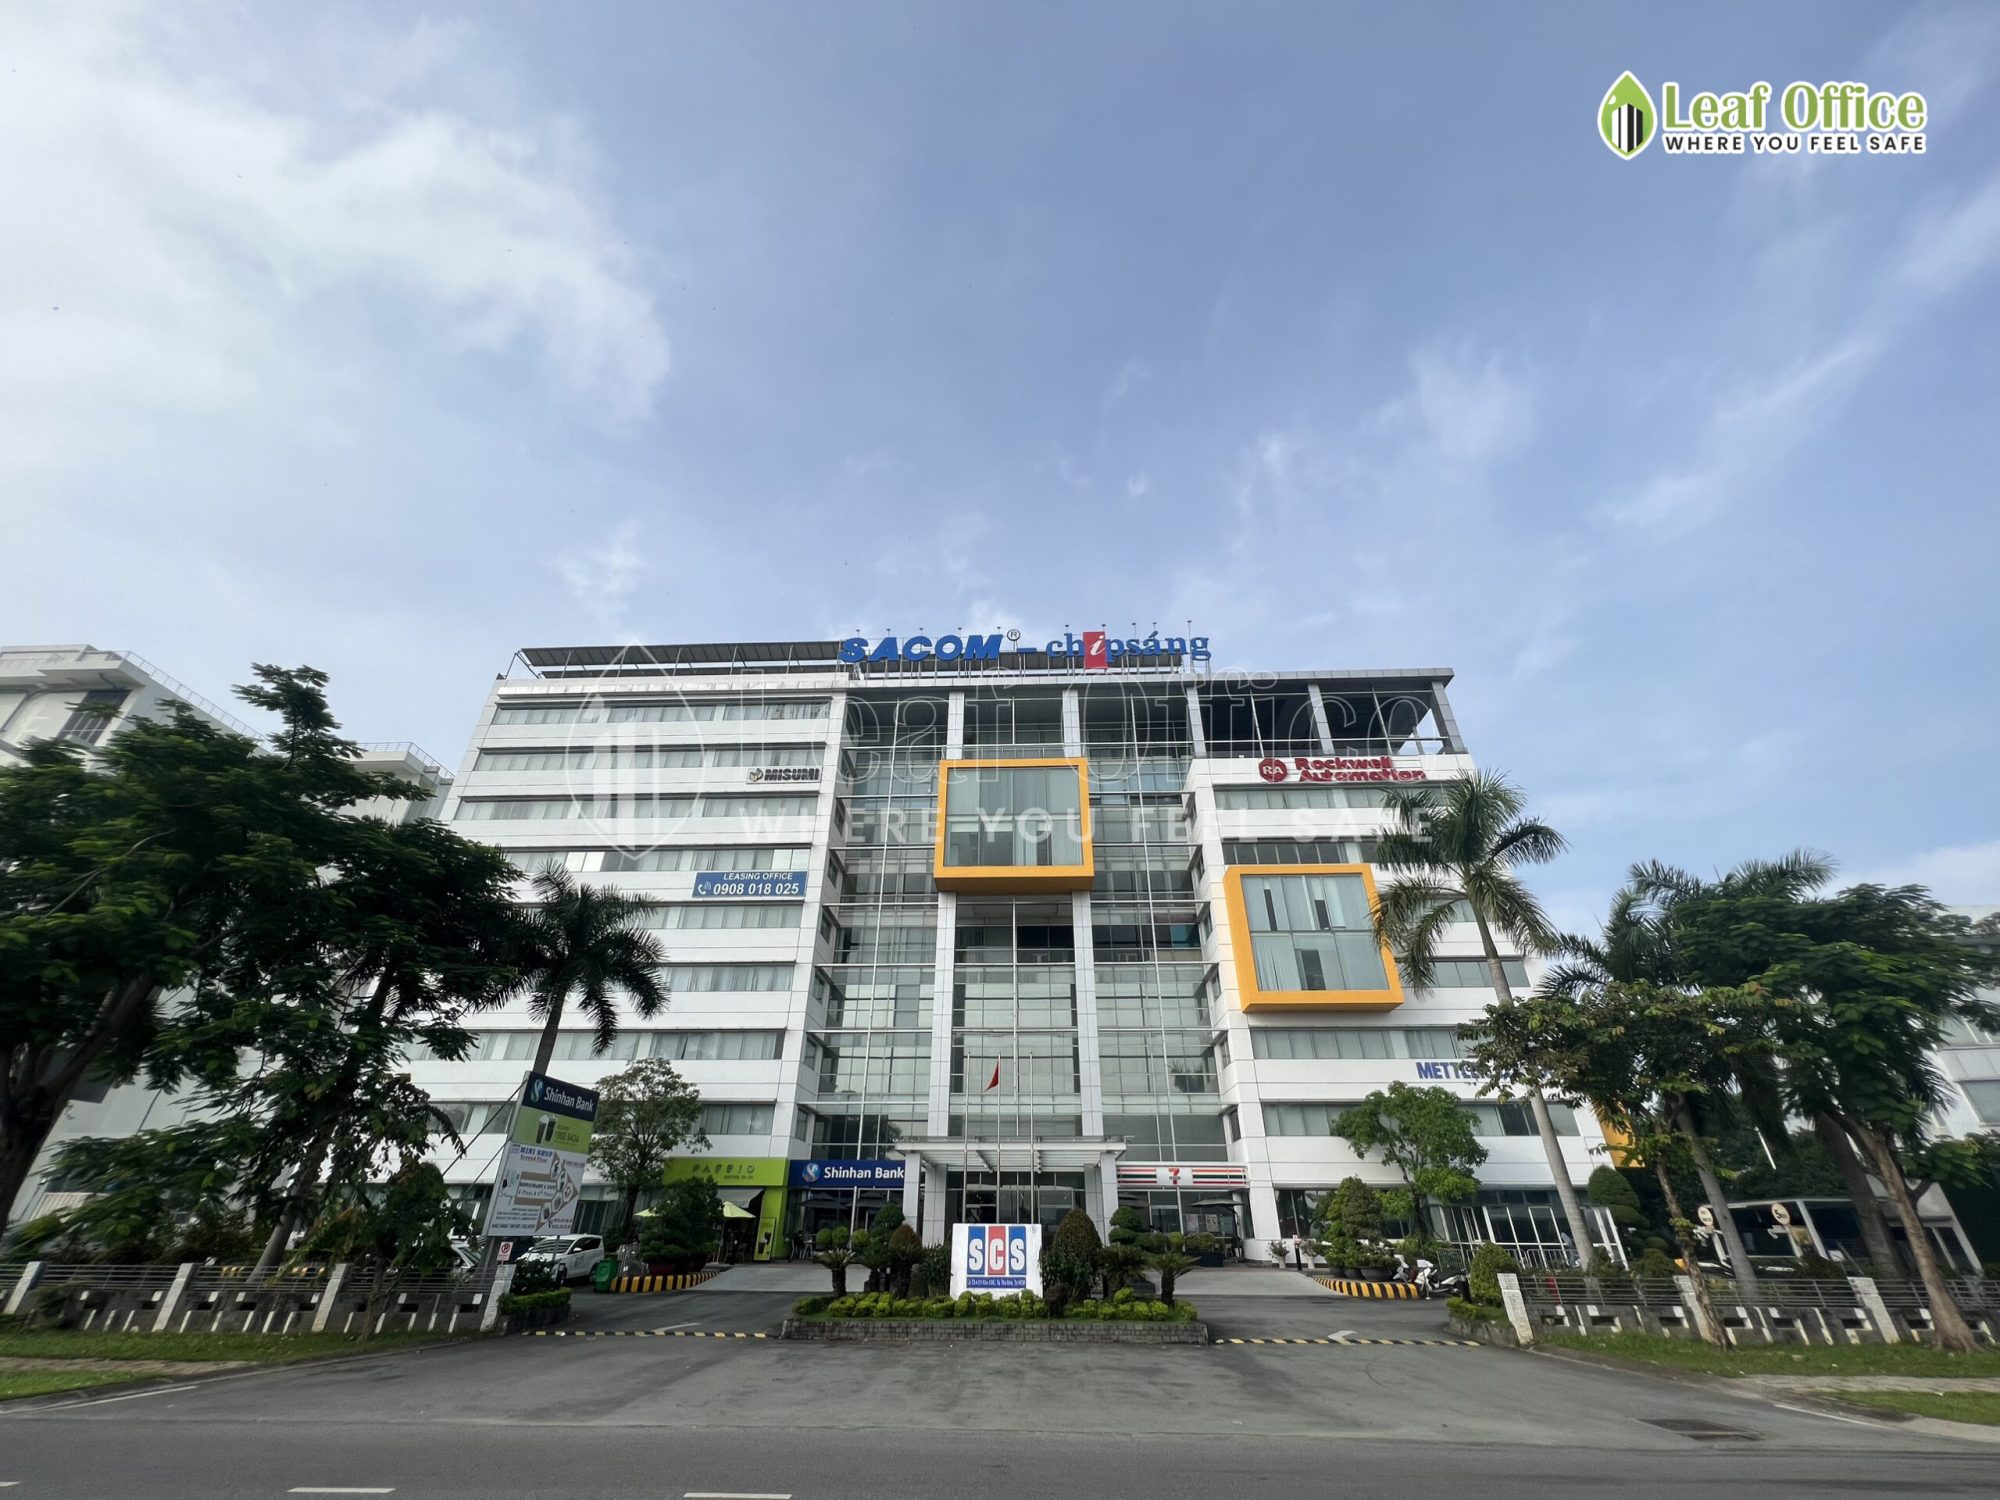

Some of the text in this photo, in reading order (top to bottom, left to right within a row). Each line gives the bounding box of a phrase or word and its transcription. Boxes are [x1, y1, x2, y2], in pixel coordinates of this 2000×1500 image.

[1262, 756, 1393, 775] RA Rockwell
[764, 768, 820, 781] MISUMI
[1299, 769, 1427, 782] Automation
[723, 872, 793, 880] LEASING OFFICE
[713, 883, 799, 895] 0908 018 025
[544, 1087, 595, 1112] Shinhan Bank
[824, 1166, 904, 1179] Shinhan Bank
[969, 1238, 1025, 1271] SCS
